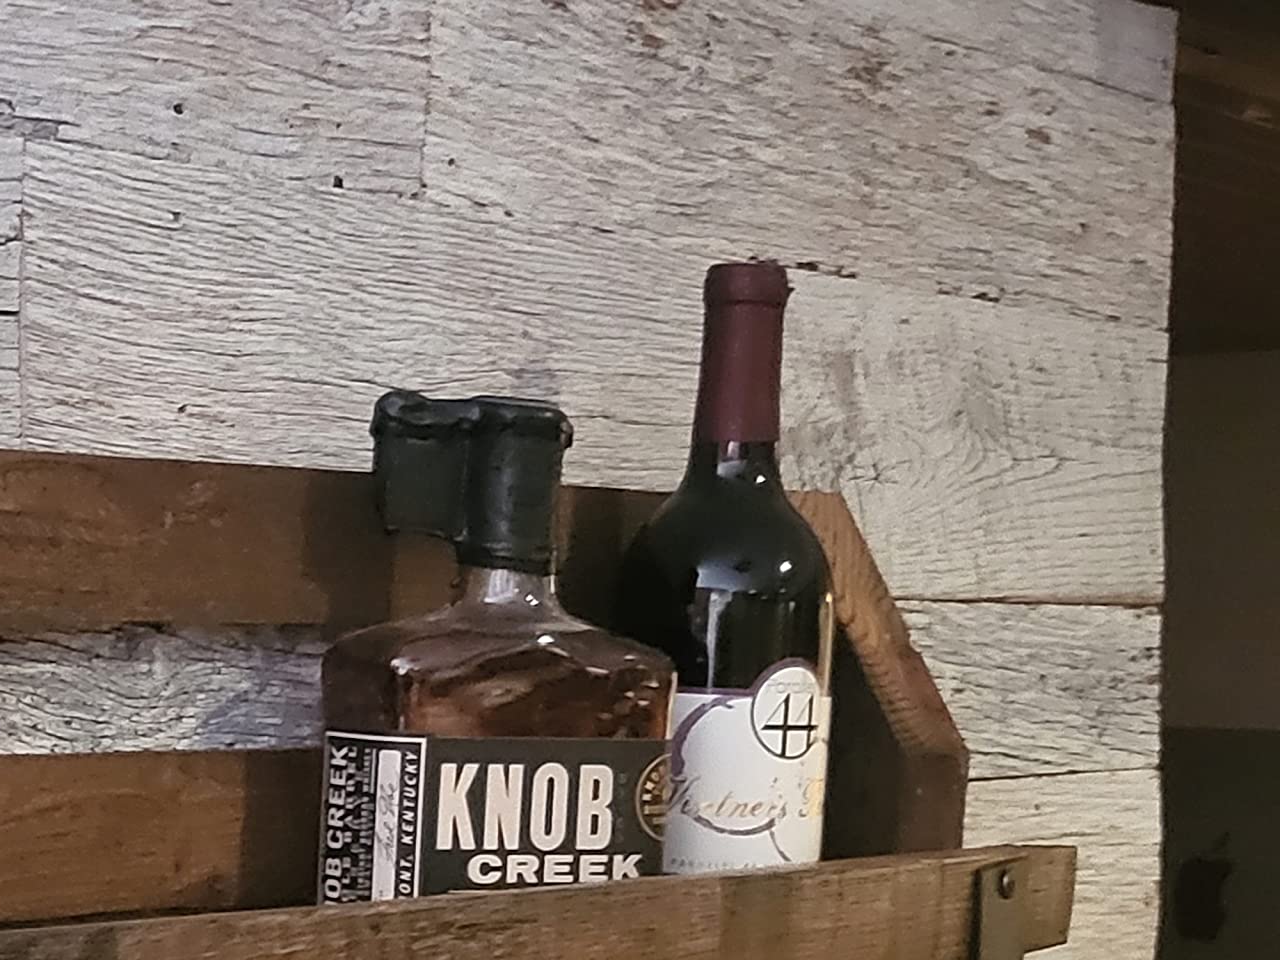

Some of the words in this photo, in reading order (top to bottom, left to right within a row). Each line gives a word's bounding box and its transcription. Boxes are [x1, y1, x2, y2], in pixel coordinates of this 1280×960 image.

[327, 746, 349, 848] CREEK
[400, 751, 418, 845] KENTUCKY
[436, 762, 614, 851] KNOB
[468, 854, 643, 886] CREEK
